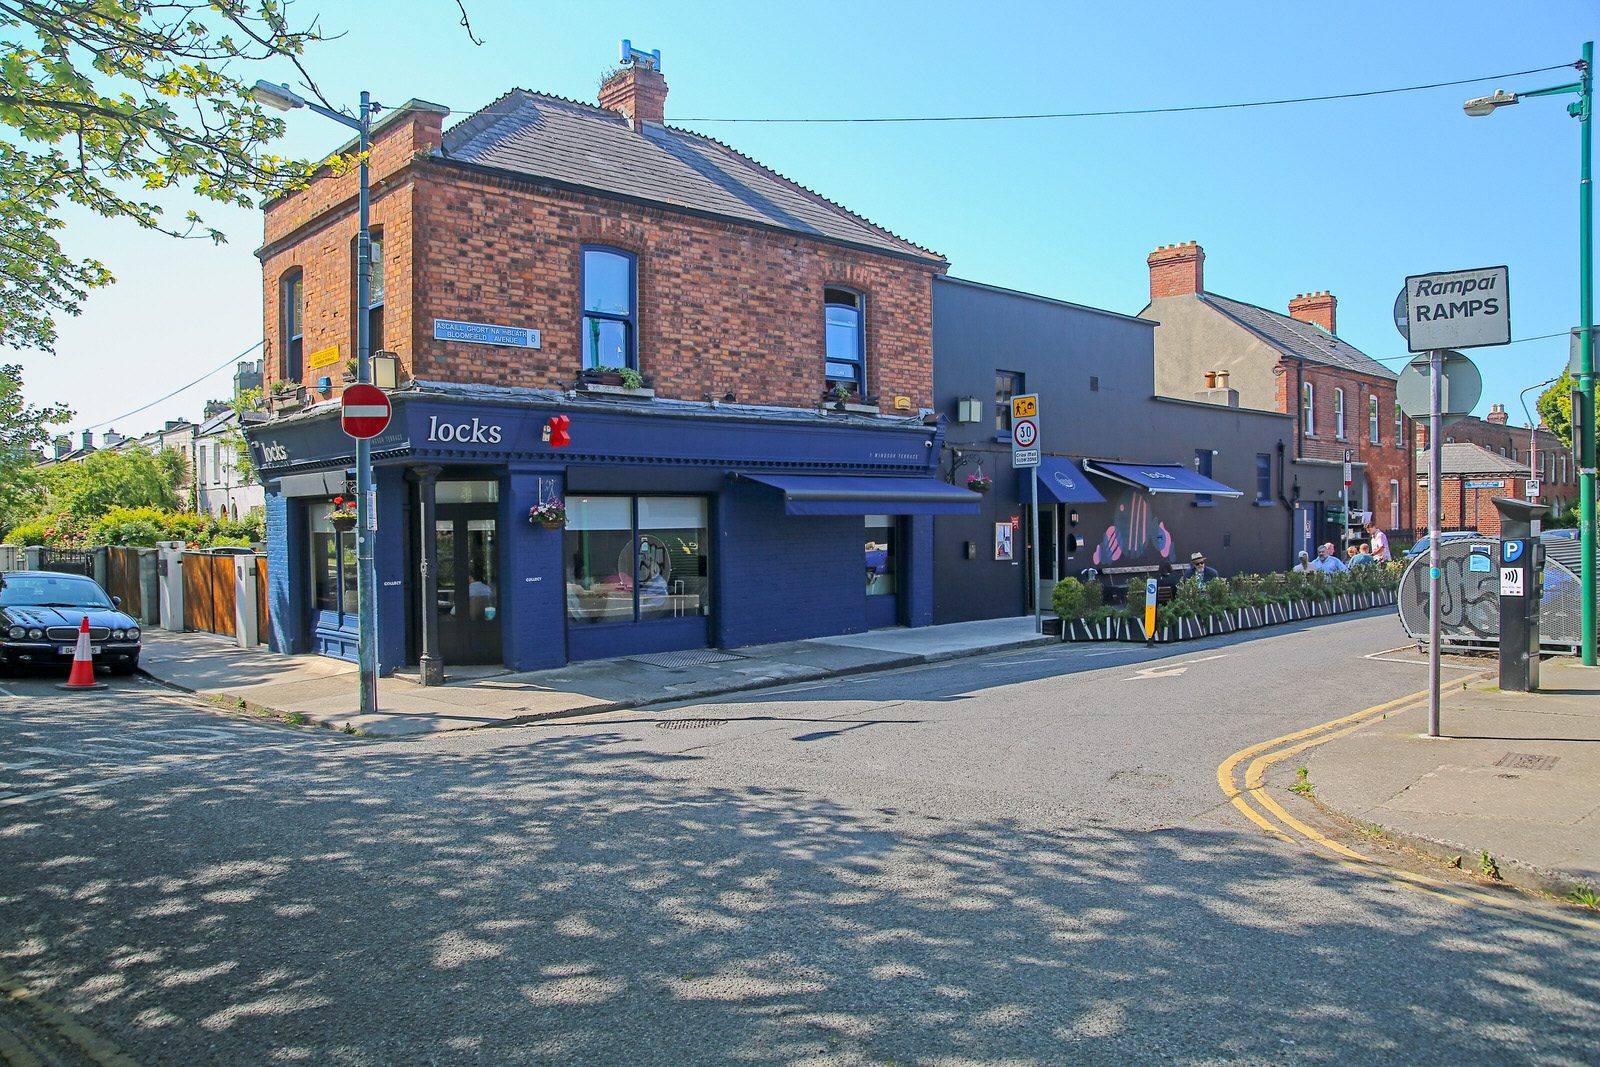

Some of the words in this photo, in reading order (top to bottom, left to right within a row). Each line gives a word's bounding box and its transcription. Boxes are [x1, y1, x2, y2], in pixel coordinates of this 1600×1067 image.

[1416, 274, 1498, 297] Rampaí
[1416, 298, 1499, 322] RAMPS
[436, 322, 464, 332] ASCAILL
[466, 325, 489, 334] GHORT
[446, 331, 487, 341] BLOOMFIELD
[494, 336, 518, 344] AVENUE
[427, 415, 502, 444] locks
[1020, 426, 1031, 438] 30
[261, 441, 288, 462] locks
[1506, 542, 1518, 558] P
